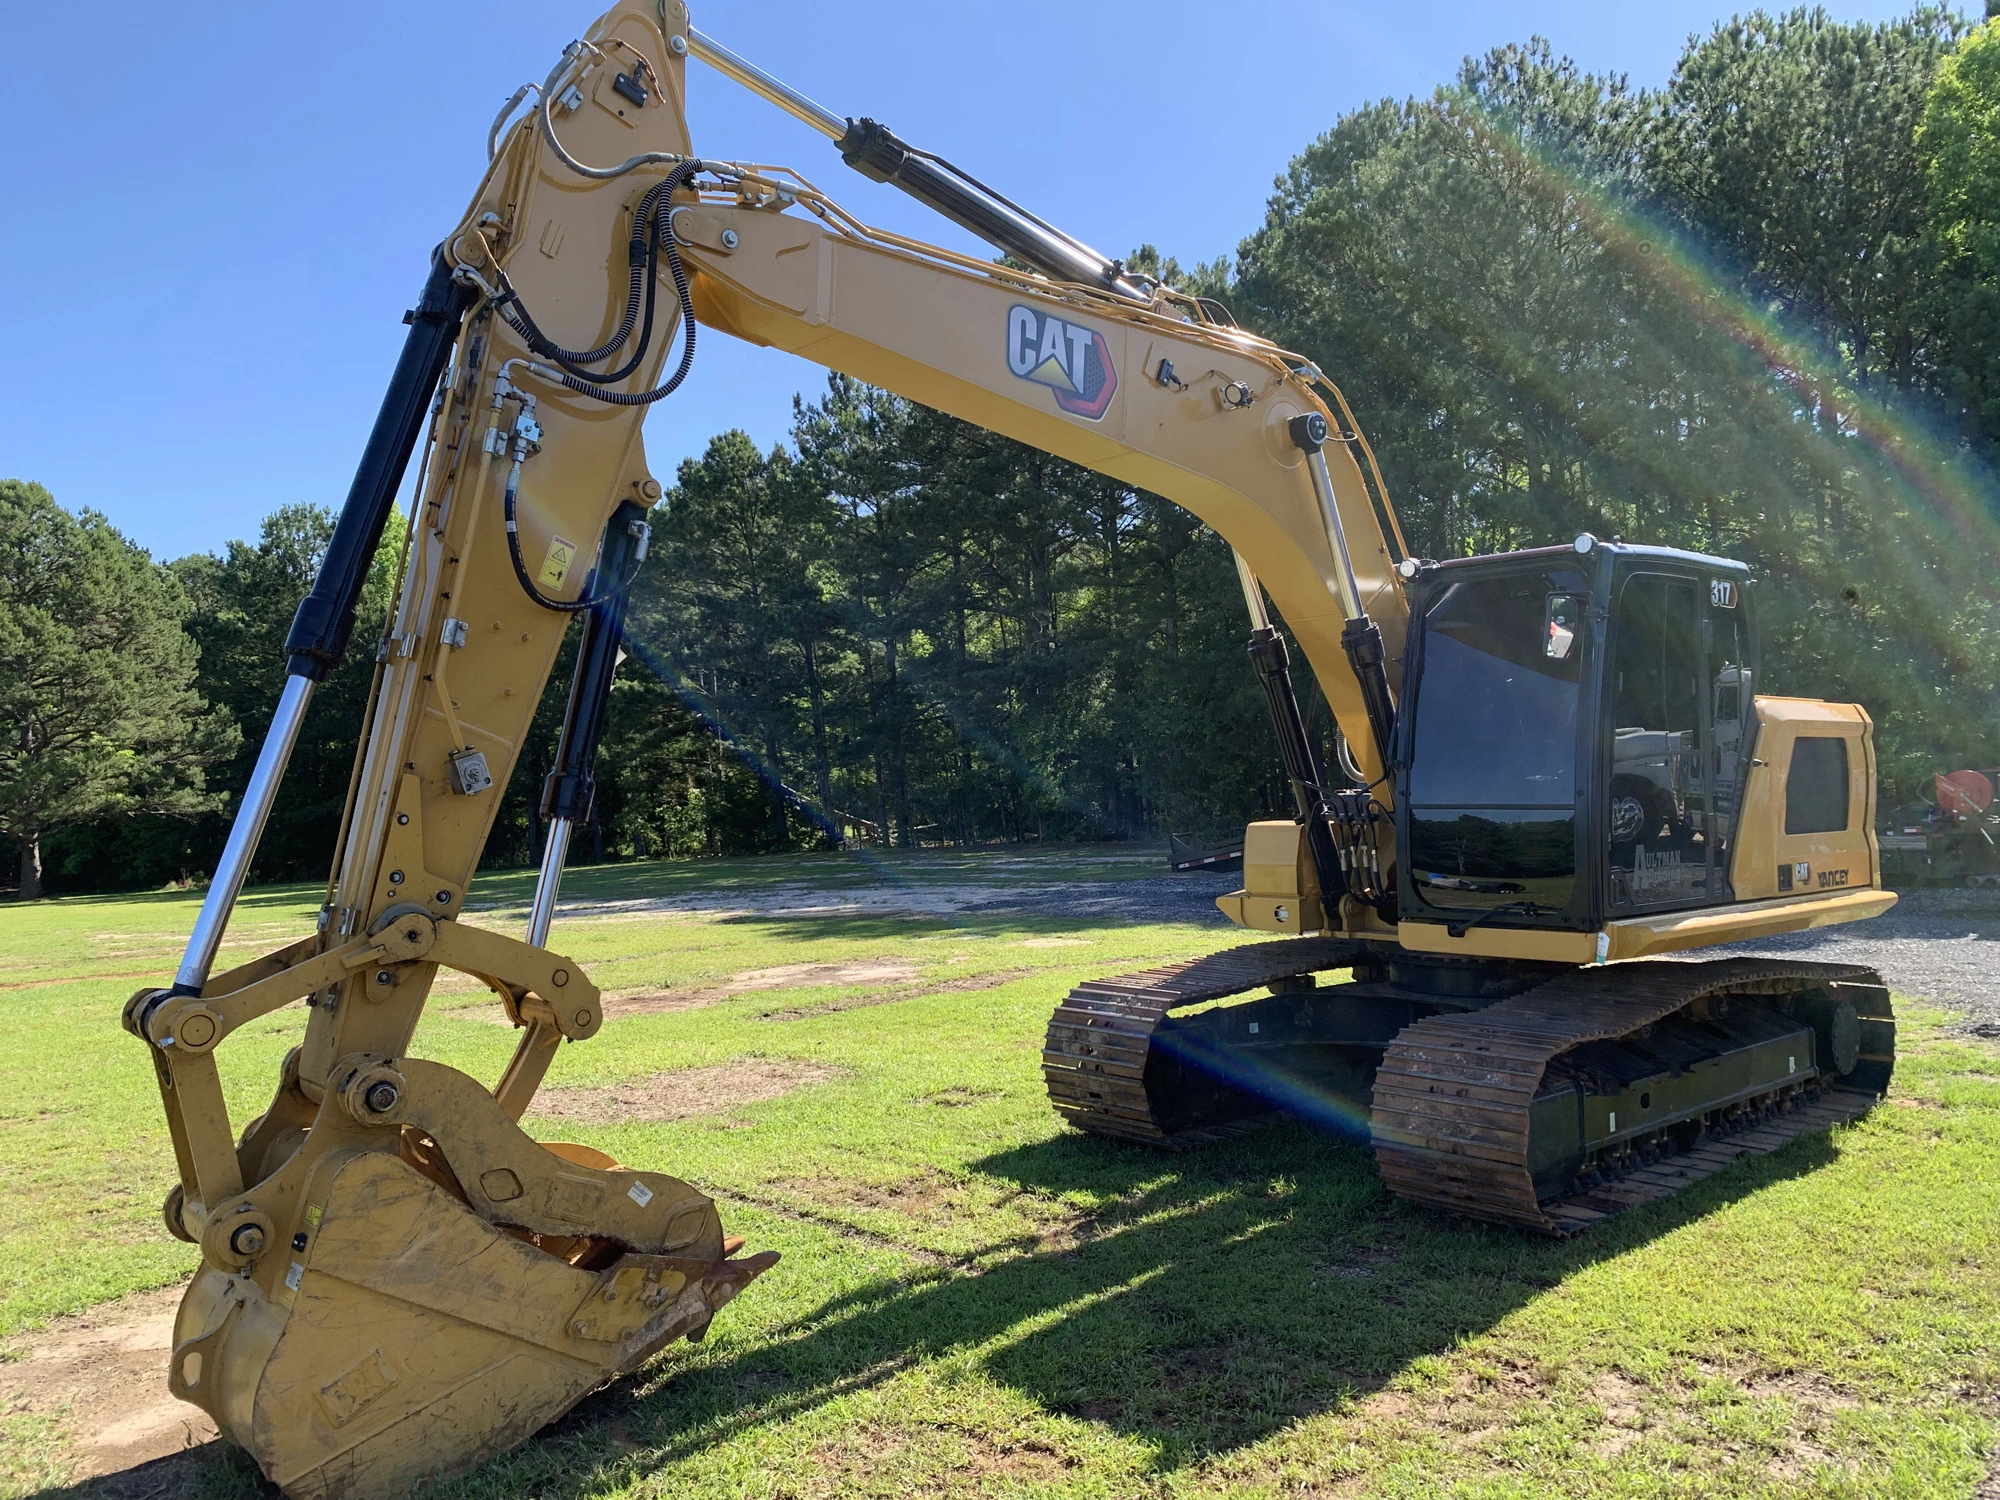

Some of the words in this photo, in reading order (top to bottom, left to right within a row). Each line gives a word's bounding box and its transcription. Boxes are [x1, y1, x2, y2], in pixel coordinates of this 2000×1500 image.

[1009, 306, 1092, 394] CAT
[1711, 579, 1731, 605] 317
[1632, 844, 1681, 890] AULTMAN
[1796, 862, 1809, 880] CAT
[1817, 869, 1849, 888] YANCEY
